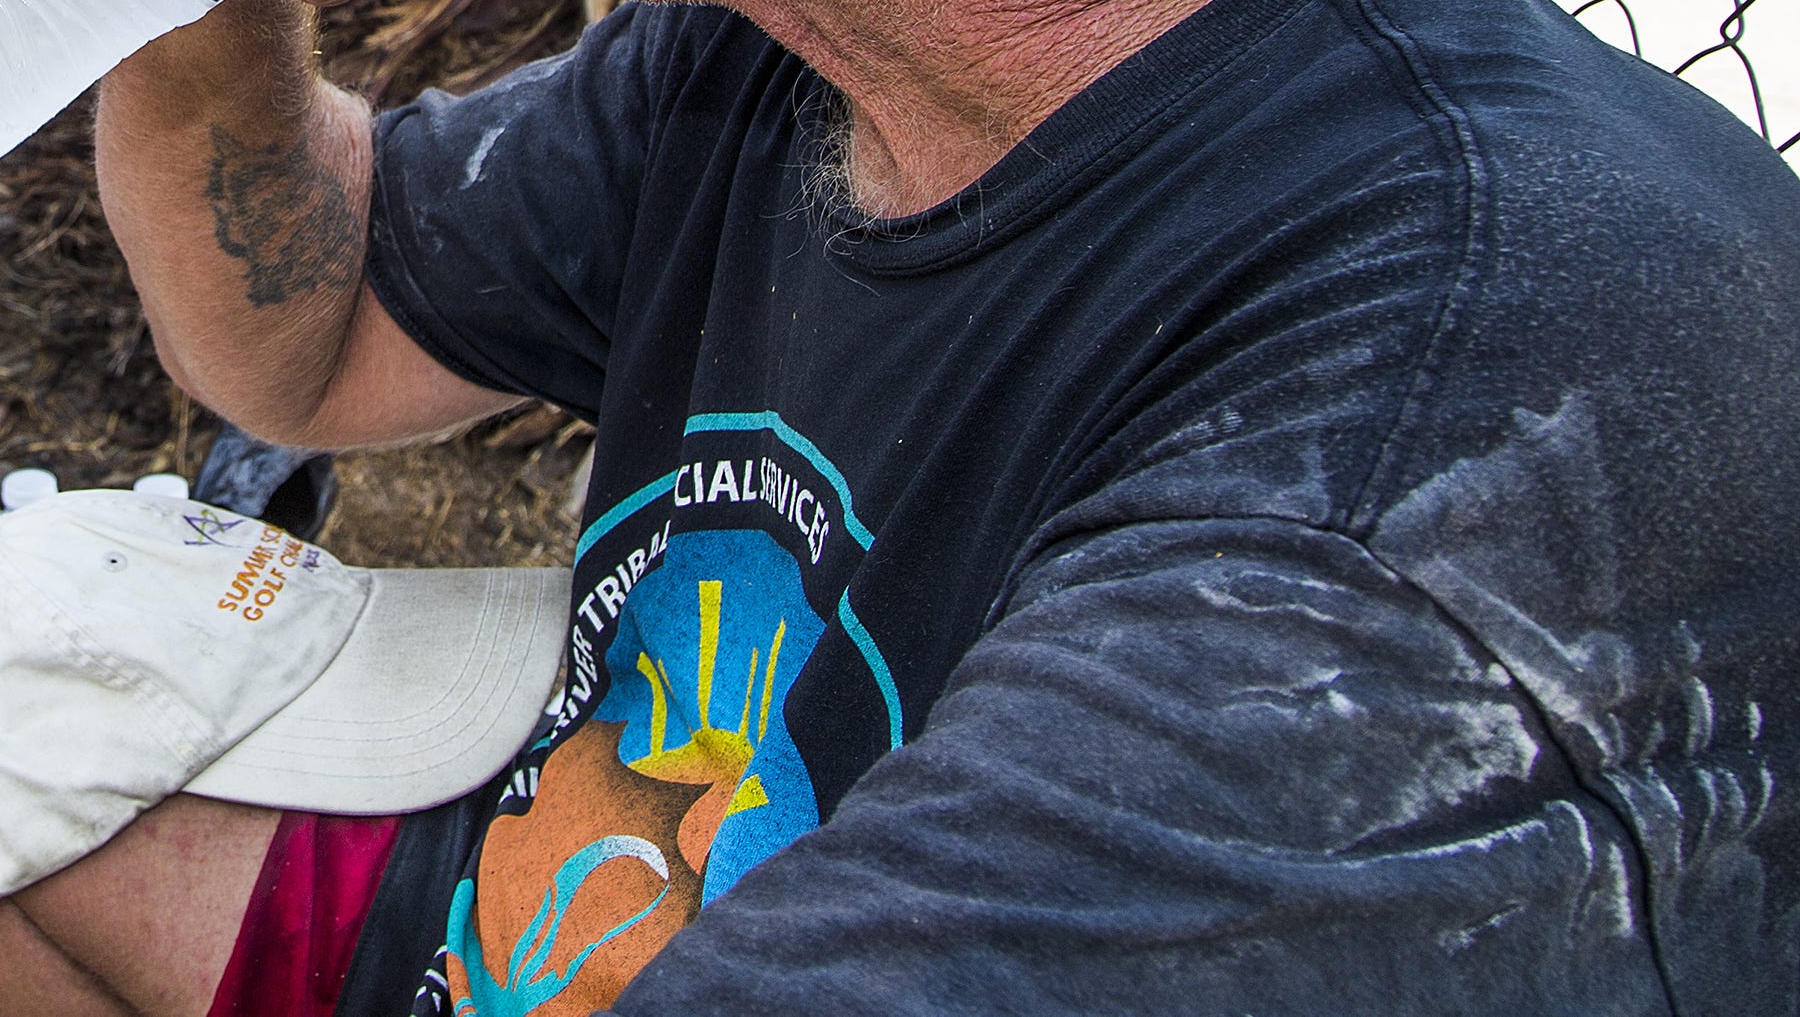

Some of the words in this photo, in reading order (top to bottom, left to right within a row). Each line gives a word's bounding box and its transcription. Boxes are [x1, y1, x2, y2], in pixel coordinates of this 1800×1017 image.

[243, 567, 287, 621] GOLF
[576, 519, 672, 633] TRIBAL
[759, 456, 830, 565] SERVICES
